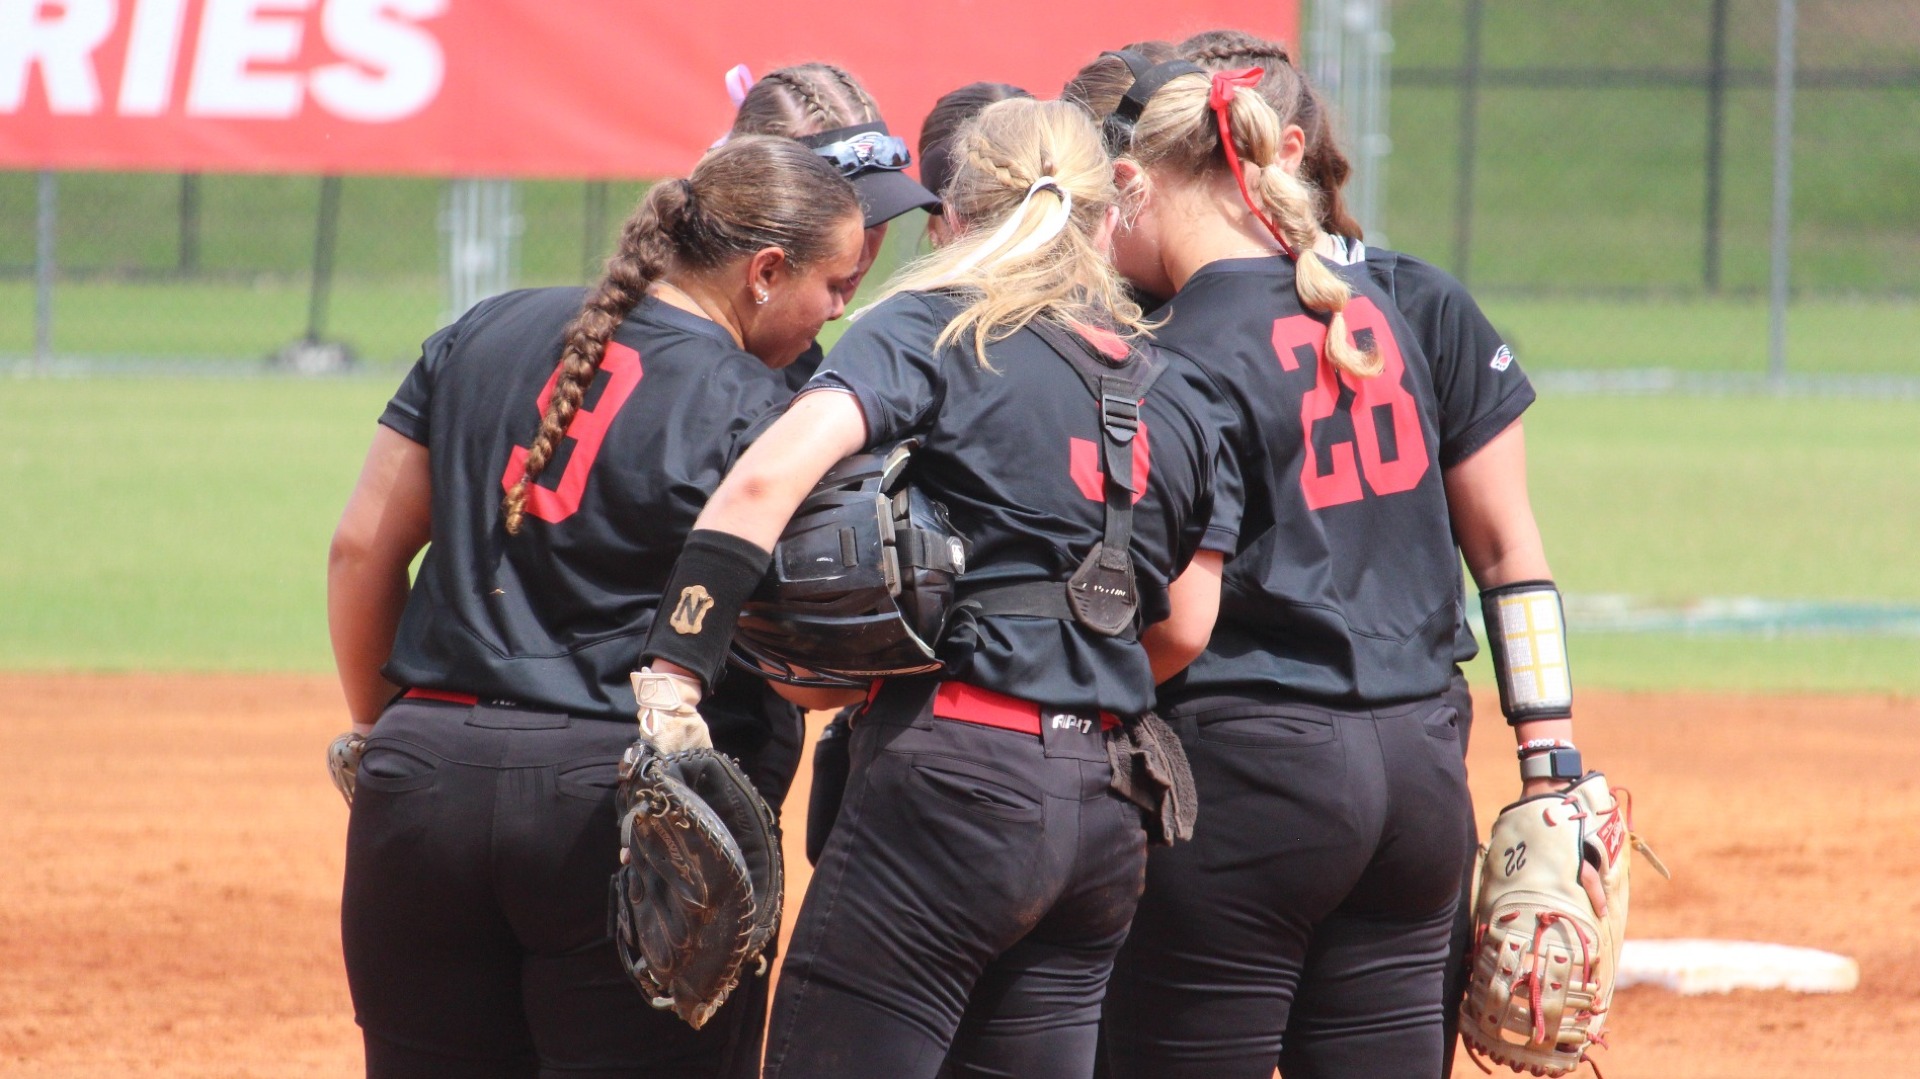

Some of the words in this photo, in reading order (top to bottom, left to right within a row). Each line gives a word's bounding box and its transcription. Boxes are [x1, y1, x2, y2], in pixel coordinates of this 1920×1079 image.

[0, 0, 448, 122] RIES
[1272, 296, 1430, 511] 28
[1504, 841, 1527, 877] 22
